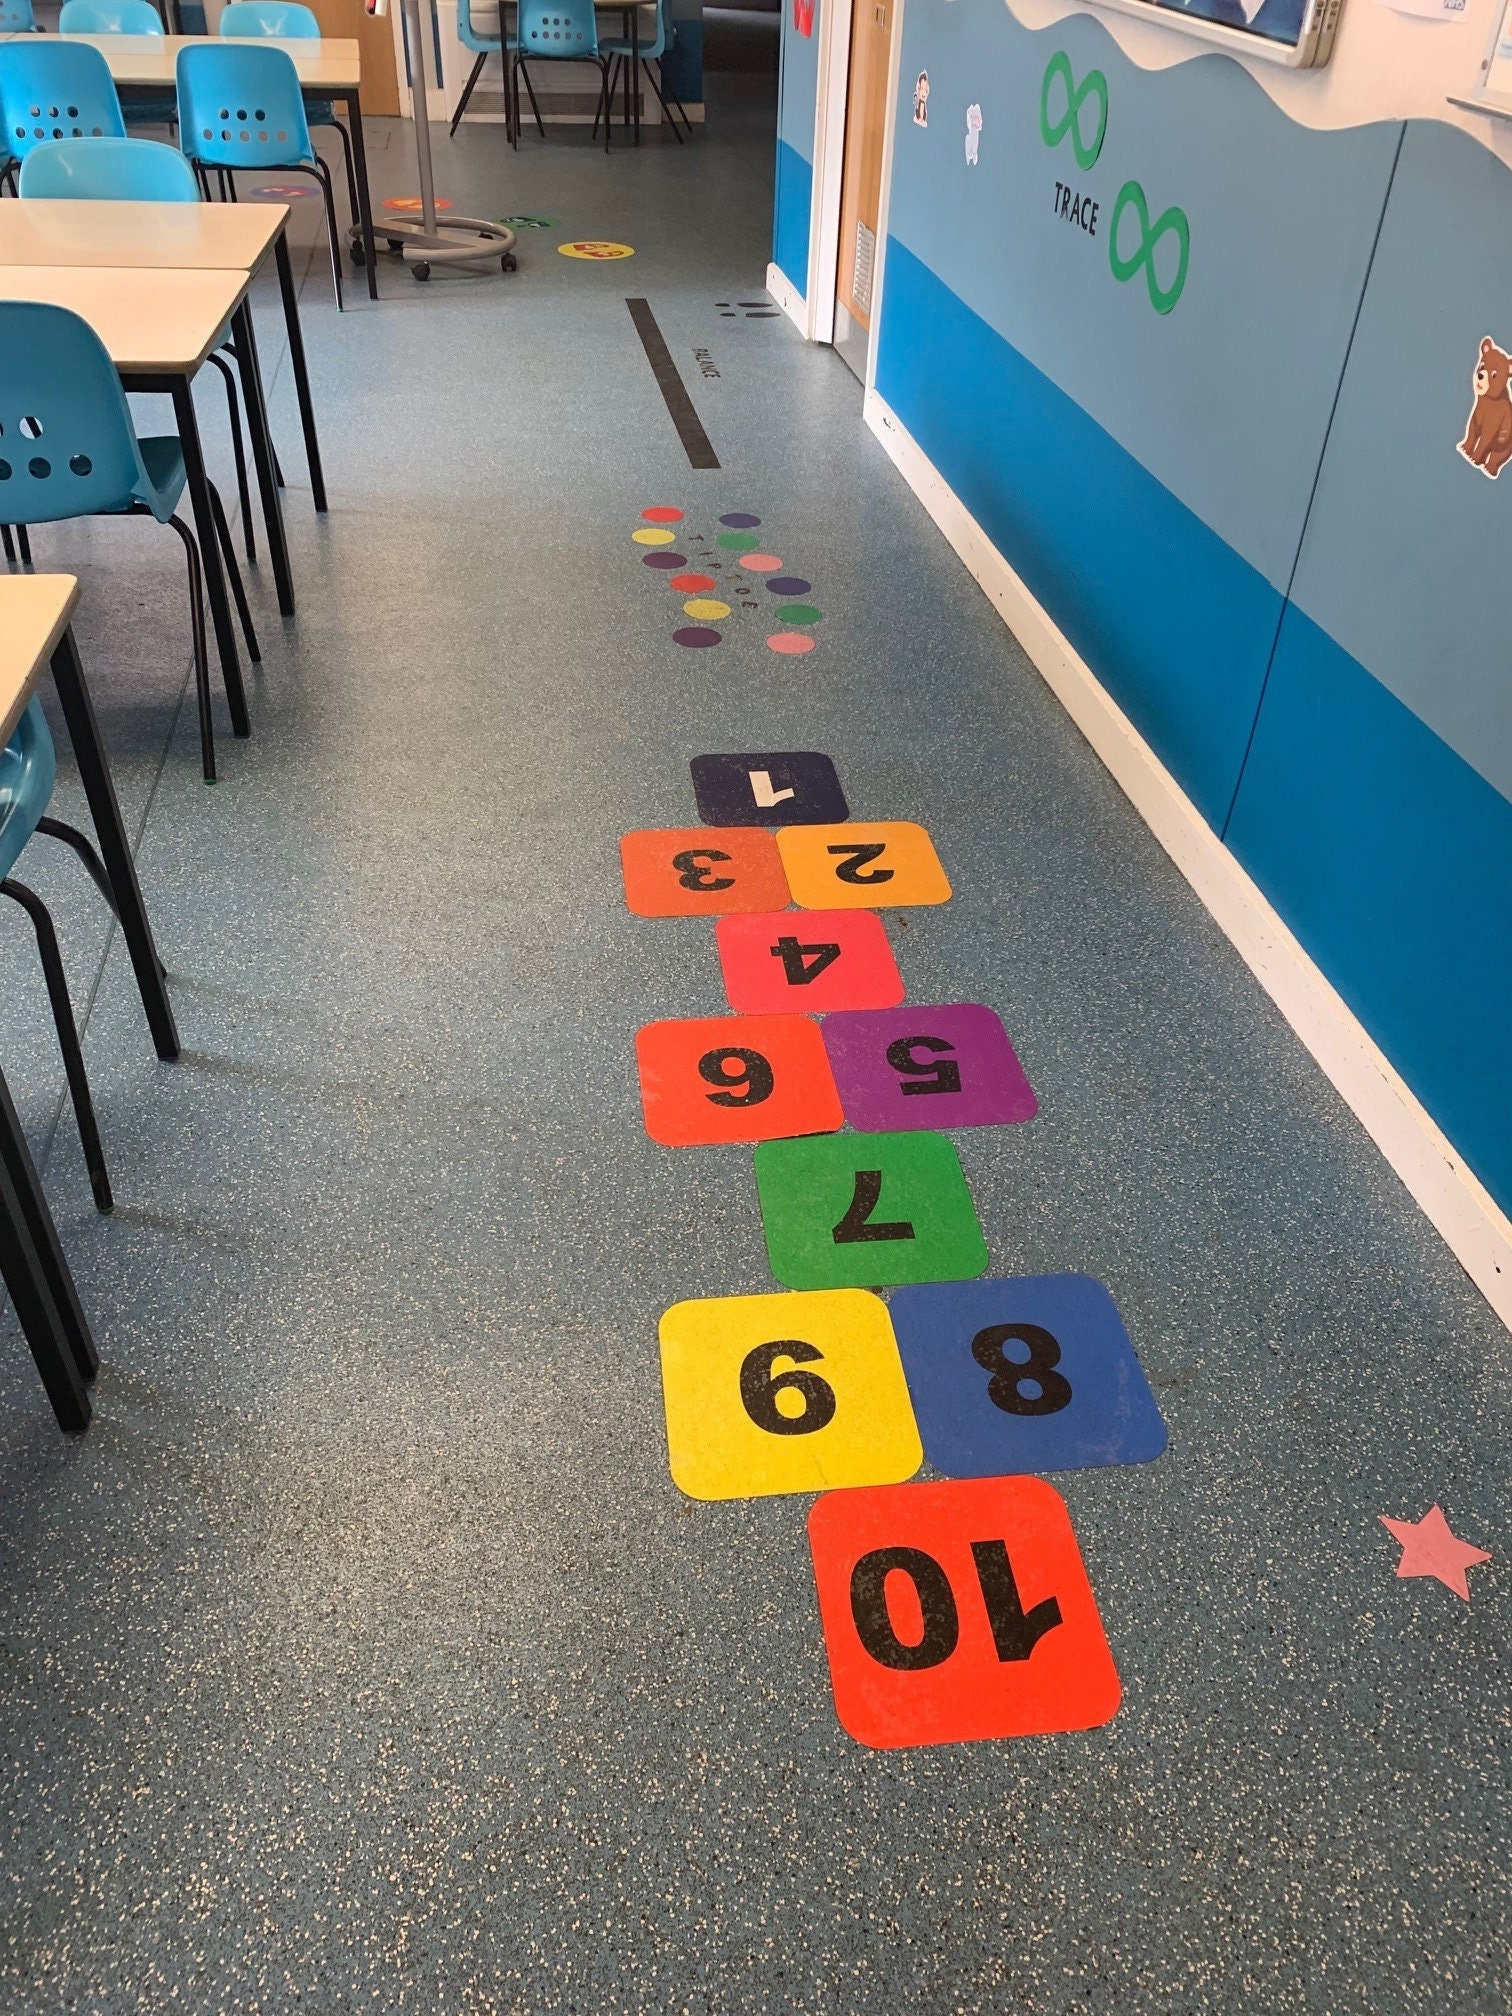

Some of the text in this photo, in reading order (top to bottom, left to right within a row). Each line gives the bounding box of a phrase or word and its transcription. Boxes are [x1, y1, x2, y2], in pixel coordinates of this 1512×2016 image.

[1054, 181, 1099, 235] TRACE
[749, 771, 795, 807] 1
[672, 849, 736, 891] 3
[827, 843, 895, 884] 2
[770, 936, 841, 985] 4
[698, 1047, 774, 1107] 6
[886, 1036, 962, 1096] 5
[832, 1170, 916, 1244] 7
[972, 1323, 1073, 1416] 8
[849, 1540, 1064, 1671] 10
